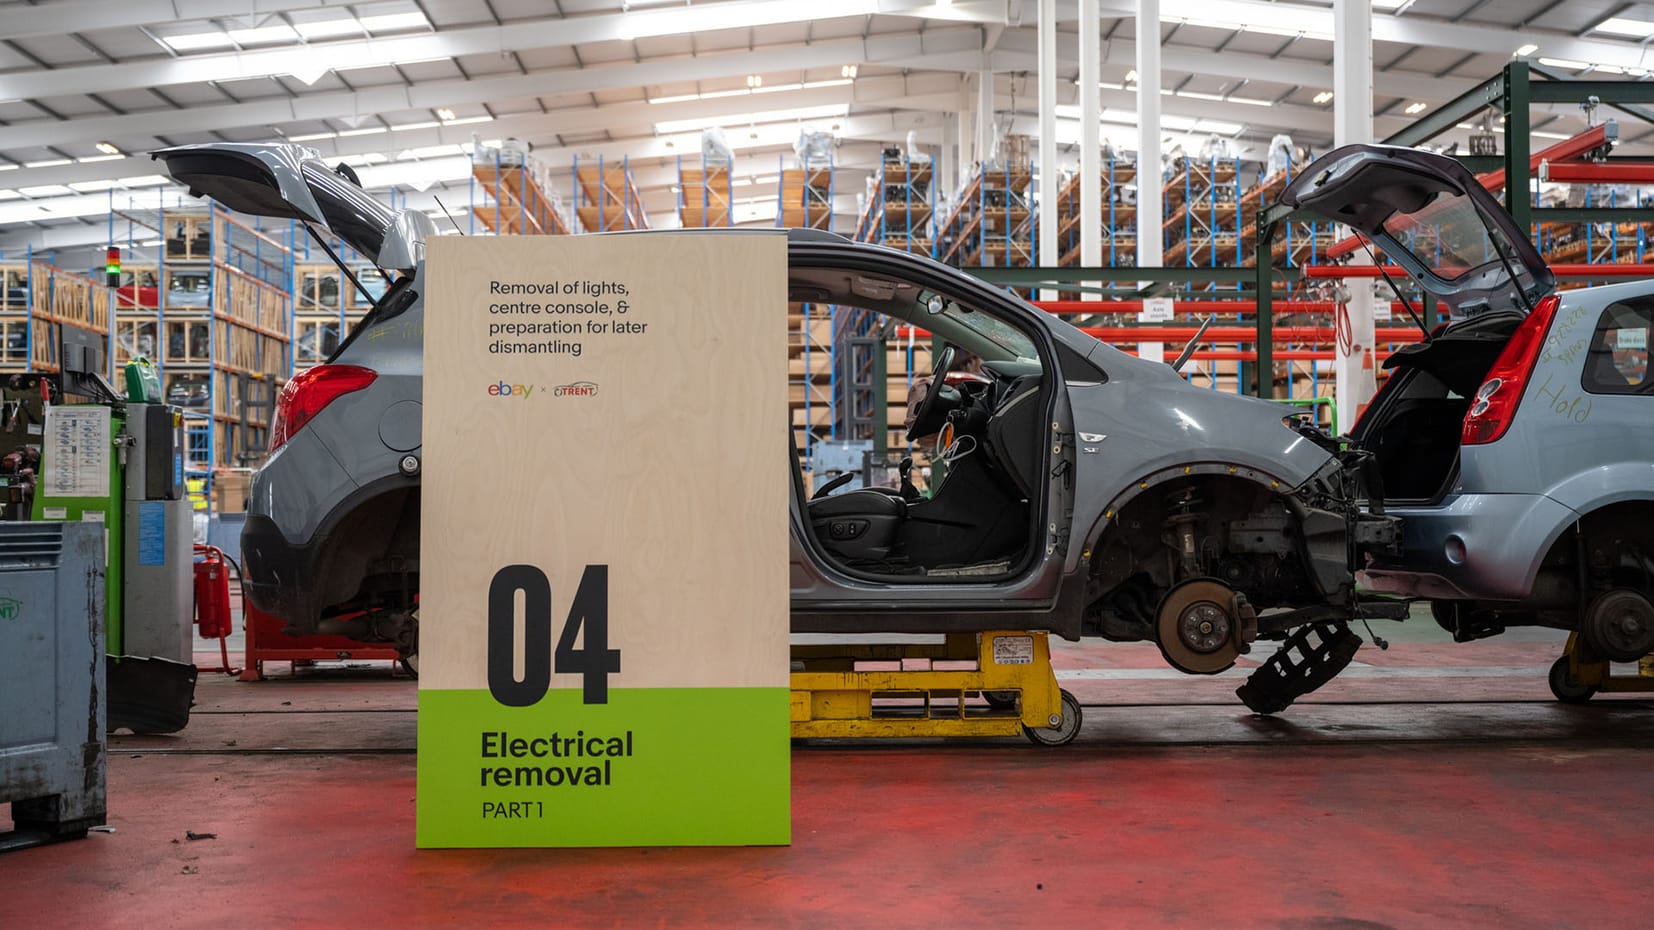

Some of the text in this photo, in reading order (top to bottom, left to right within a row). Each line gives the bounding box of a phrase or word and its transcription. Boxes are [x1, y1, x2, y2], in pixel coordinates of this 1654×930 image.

[490, 281, 630, 298] Removal of lights,
[489, 300, 630, 317] centre console, &
[489, 320, 648, 337] preparation for later
[488, 340, 582, 356] dismantling
[488, 380, 534, 399] ebay
[561, 387, 595, 396] TRENT
[1535, 371, 1593, 424] Hold
[487, 564, 621, 708] 04
[481, 731, 633, 758] Electrical
[480, 760, 611, 787] removal
[483, 801, 533, 818] PART
